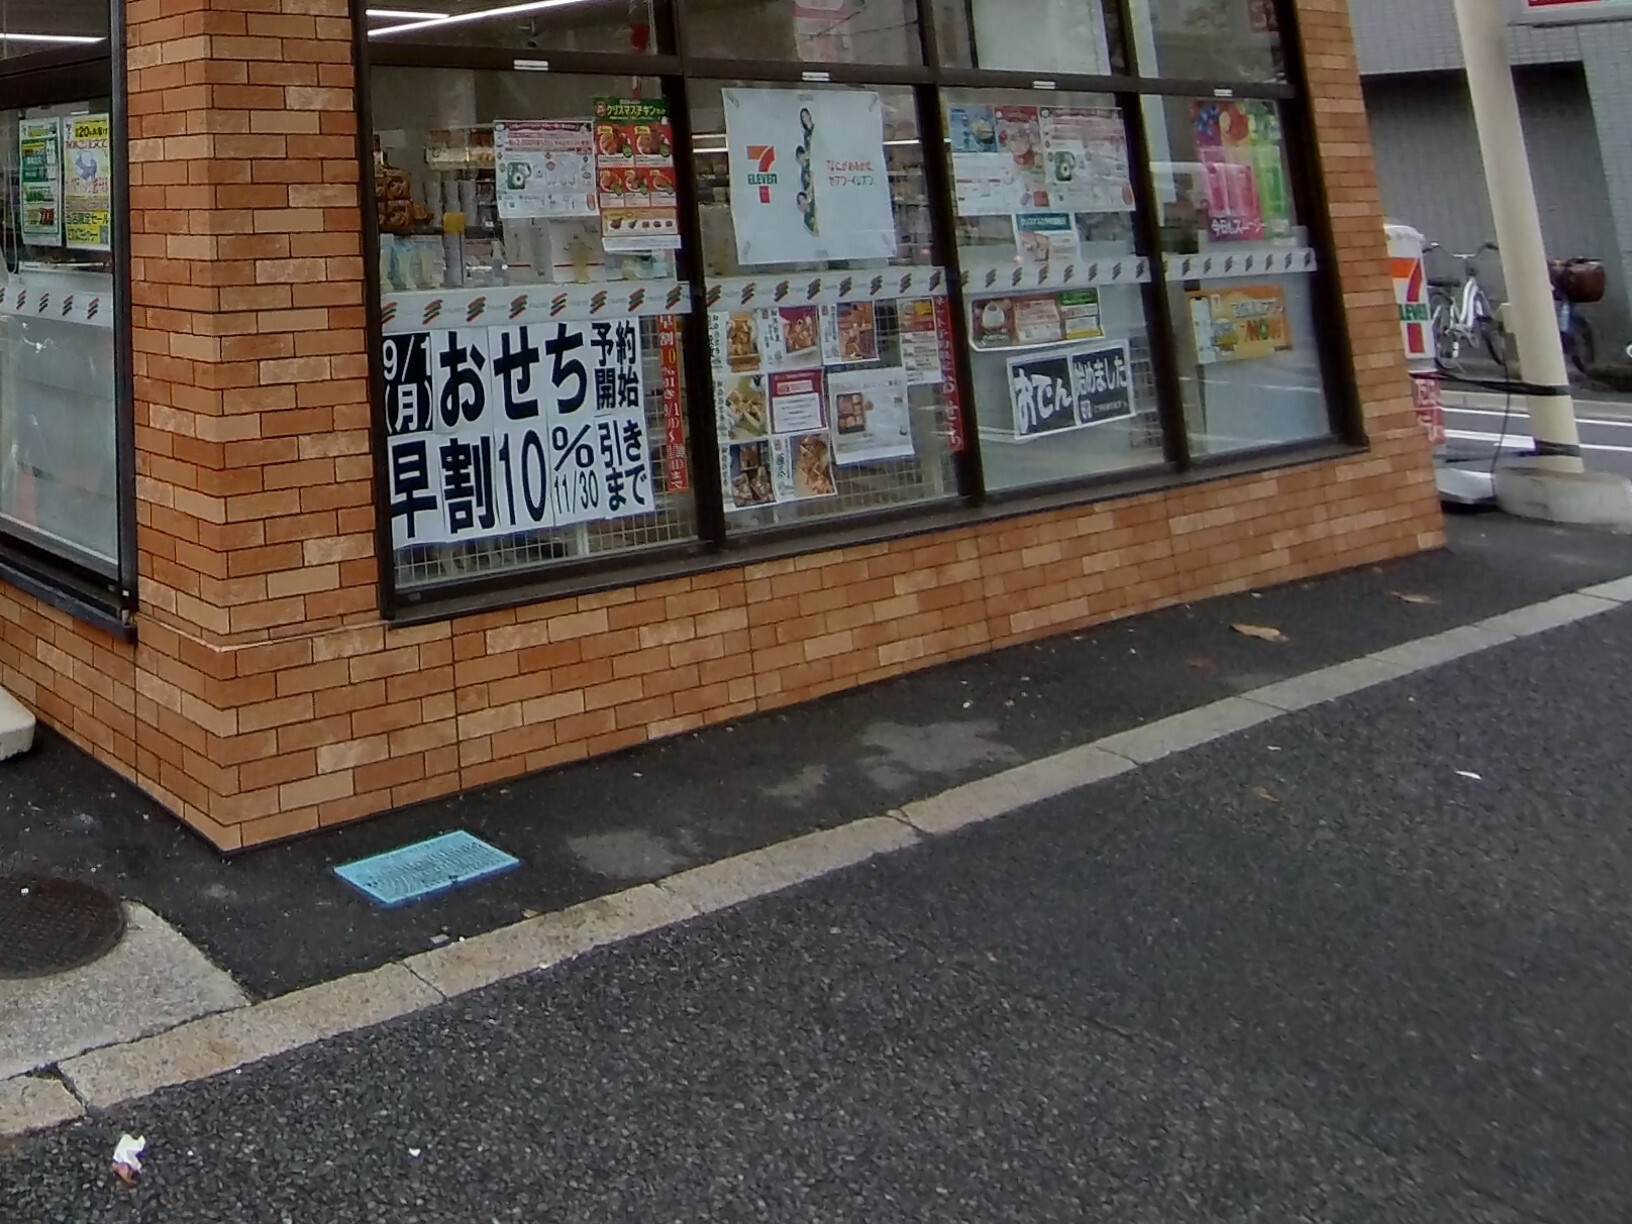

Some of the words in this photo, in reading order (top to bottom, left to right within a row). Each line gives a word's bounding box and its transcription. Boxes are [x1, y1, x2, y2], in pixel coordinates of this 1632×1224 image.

[382, 335, 432, 382] 9/1
[439, 323, 587, 427] おせち
[1014, 368, 1073, 434] おでん
